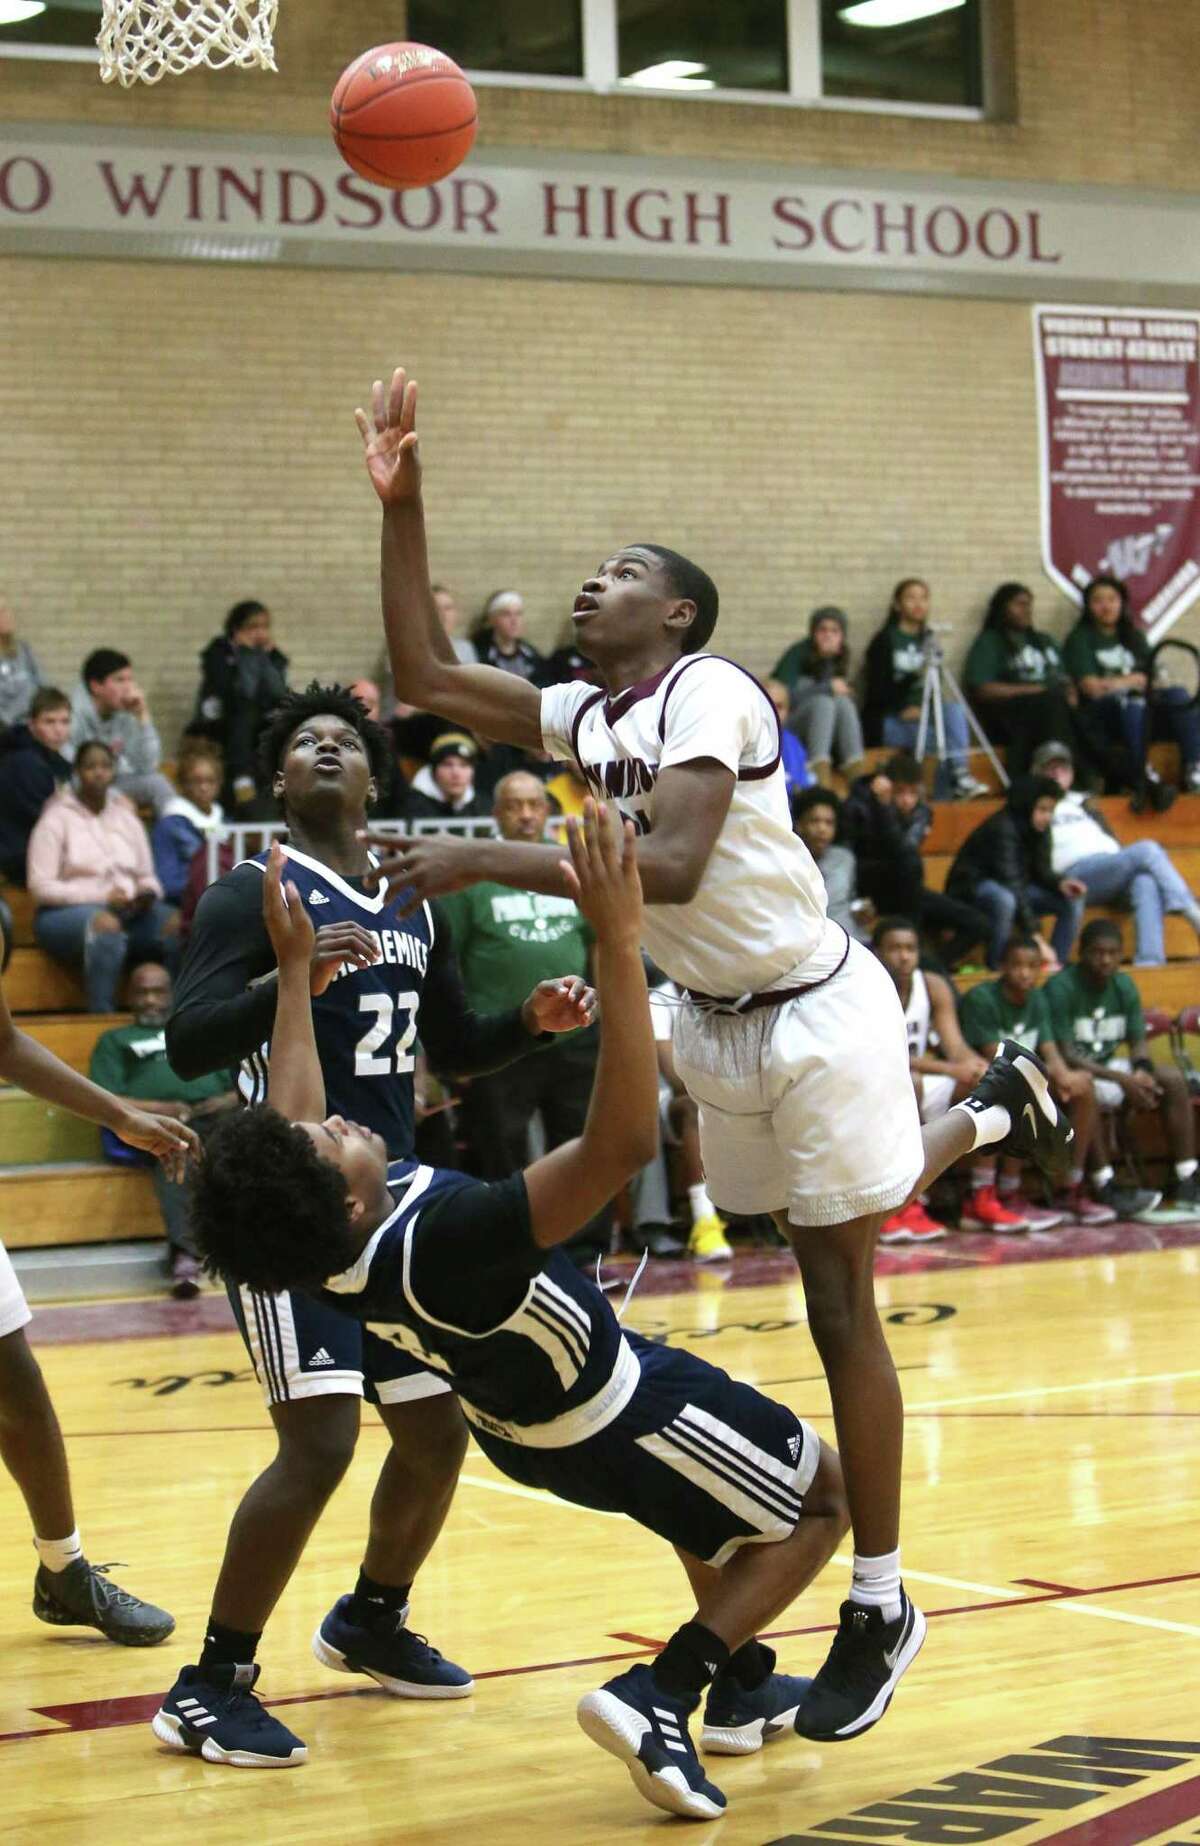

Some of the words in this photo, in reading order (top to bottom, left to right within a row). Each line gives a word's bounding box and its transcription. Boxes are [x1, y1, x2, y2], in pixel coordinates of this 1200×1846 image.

[98, 160, 499, 234] WINDSOR
[543, 182, 731, 246] HIGH
[771, 195, 1062, 263] SCHOOL
[355, 991, 420, 1076] 22
